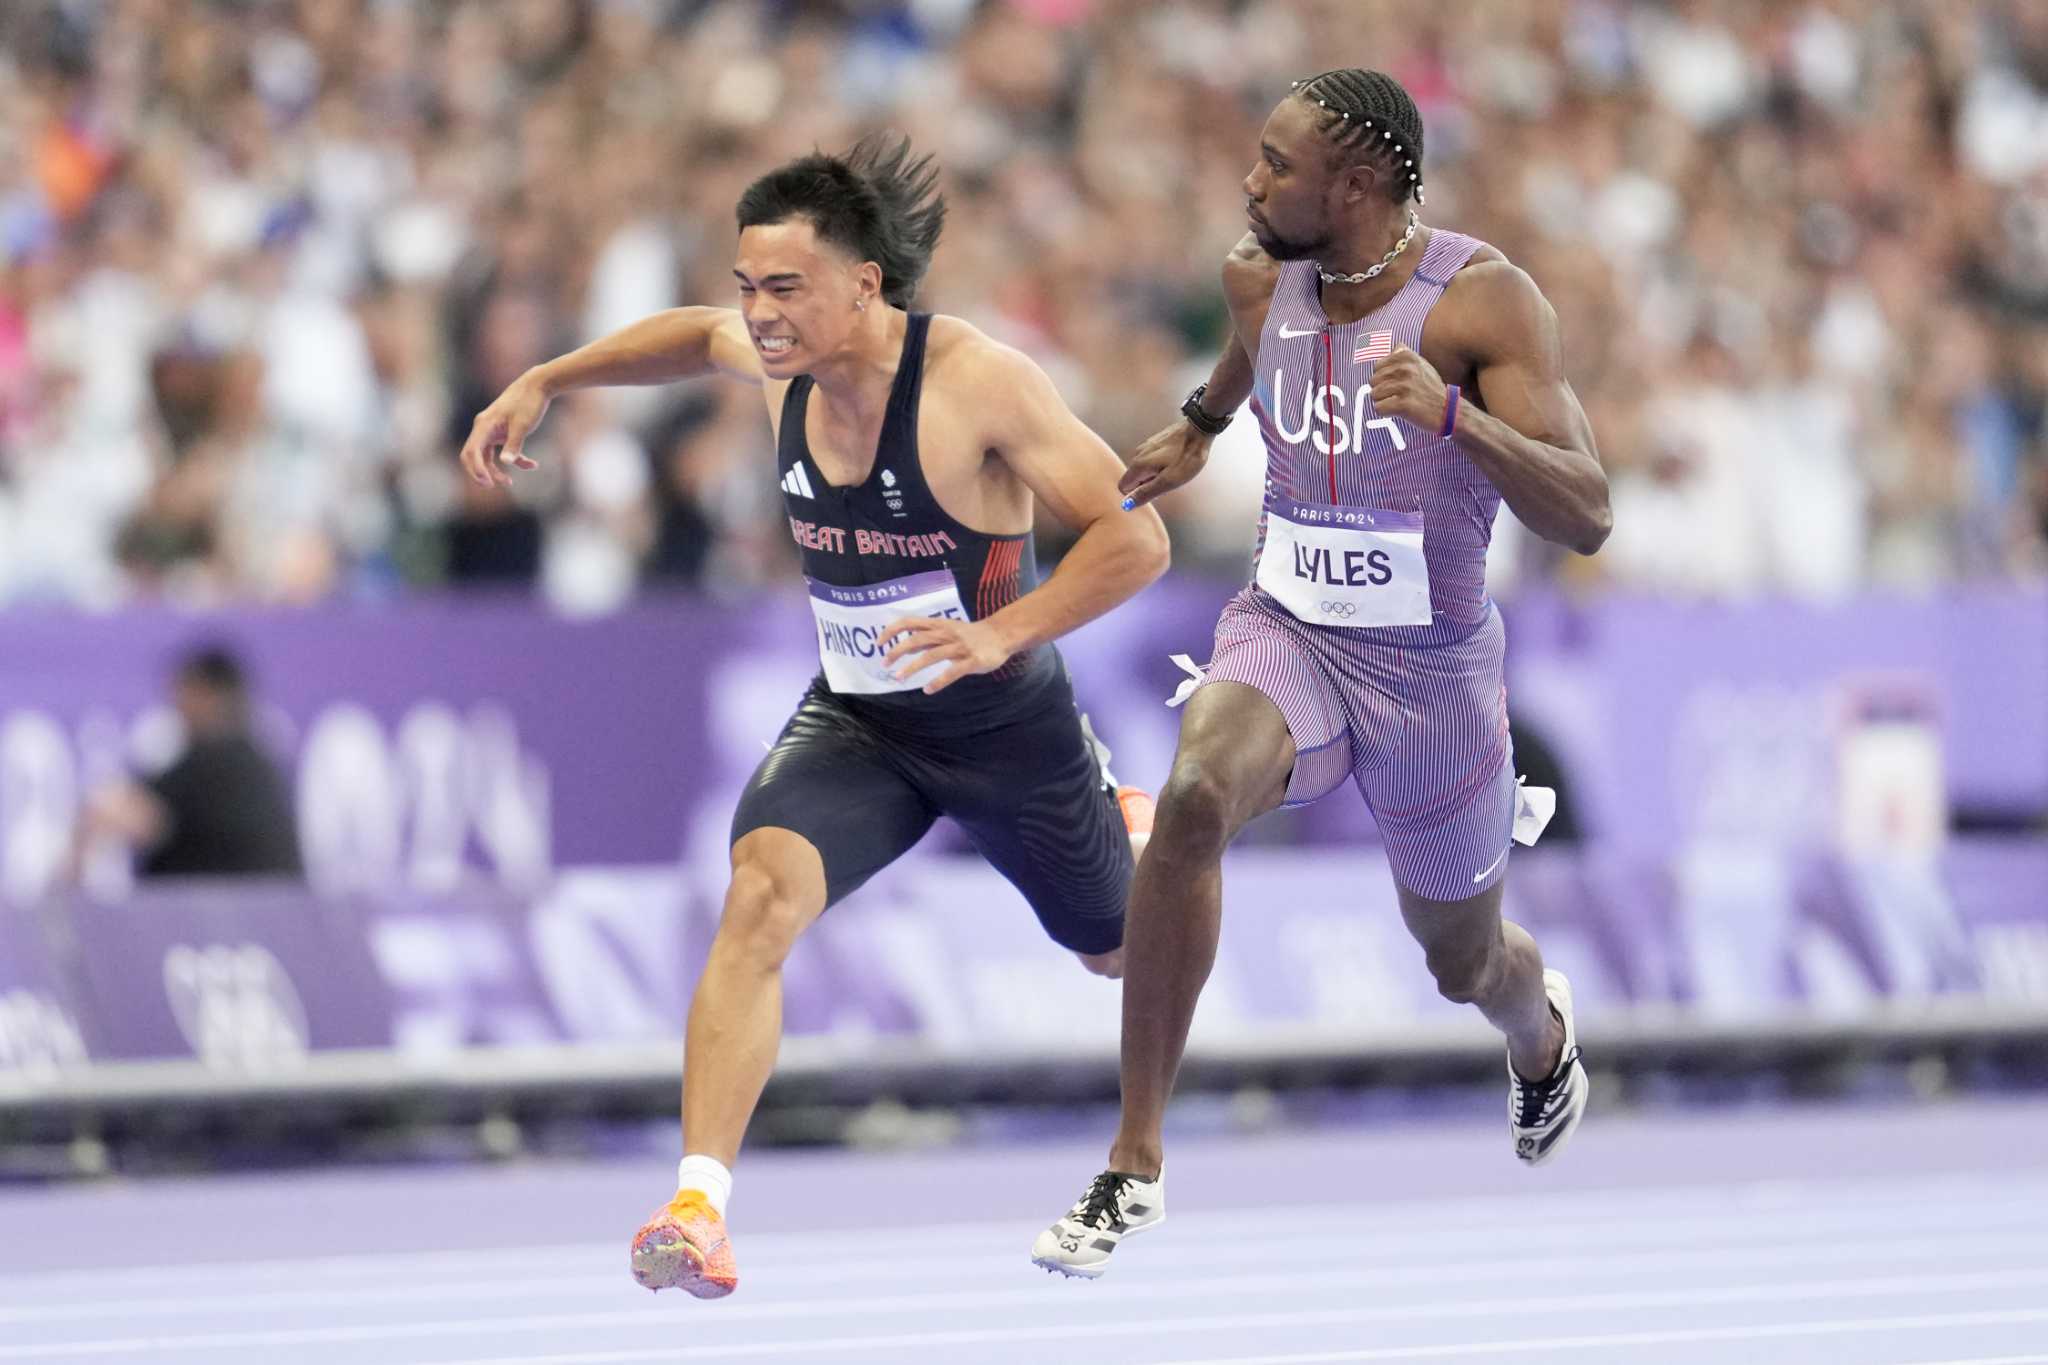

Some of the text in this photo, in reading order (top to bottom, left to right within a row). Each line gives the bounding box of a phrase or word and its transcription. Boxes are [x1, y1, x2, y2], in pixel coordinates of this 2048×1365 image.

[1274, 368, 1407, 455] USA
[1292, 506, 1375, 525] PARIS 2024
[855, 529, 957, 557] BRITAIN
[1293, 540, 1393, 586] LYLES
[831, 584, 909, 602] PARIS 2024
